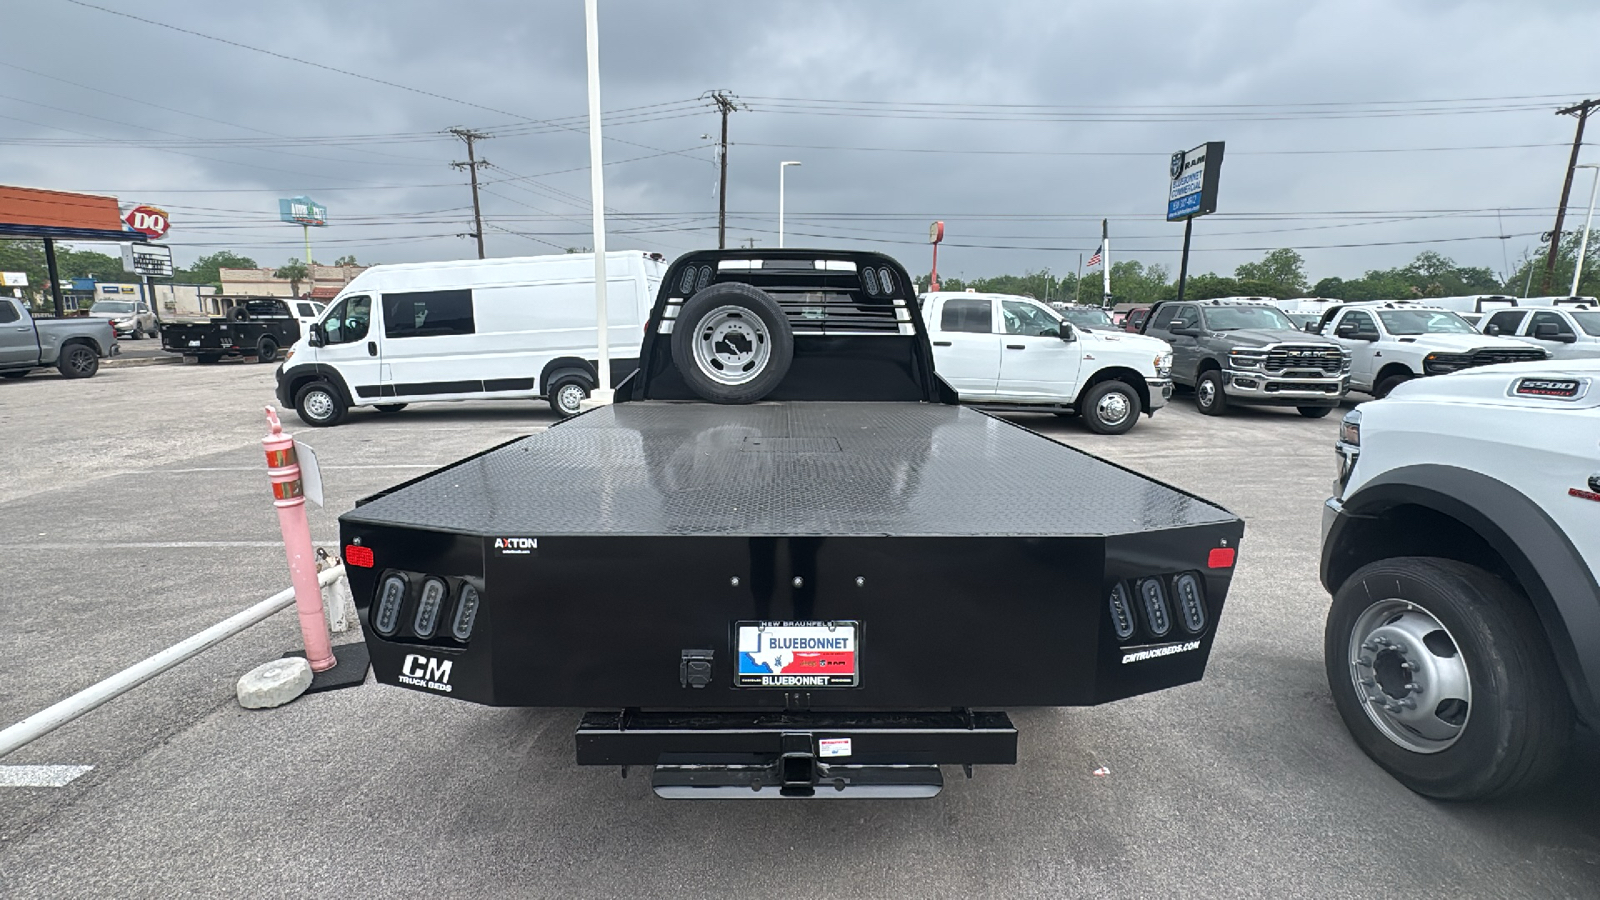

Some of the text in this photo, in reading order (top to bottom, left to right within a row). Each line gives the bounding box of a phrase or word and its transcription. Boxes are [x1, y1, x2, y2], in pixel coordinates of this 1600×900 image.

[1185, 155, 1206, 170] RAM
[133, 212, 165, 233] DQ
[1522, 381, 1575, 390] 5500
[494, 538, 538, 548] AXTON
[769, 637, 849, 649] BLUEBONNET
[1121, 640, 1200, 664] CMTRUCKBEDS.COM
[402, 654, 453, 684] CM
[398, 675, 452, 692] TRUCK BEDS
[762, 676, 830, 686] BLUEBONNET
